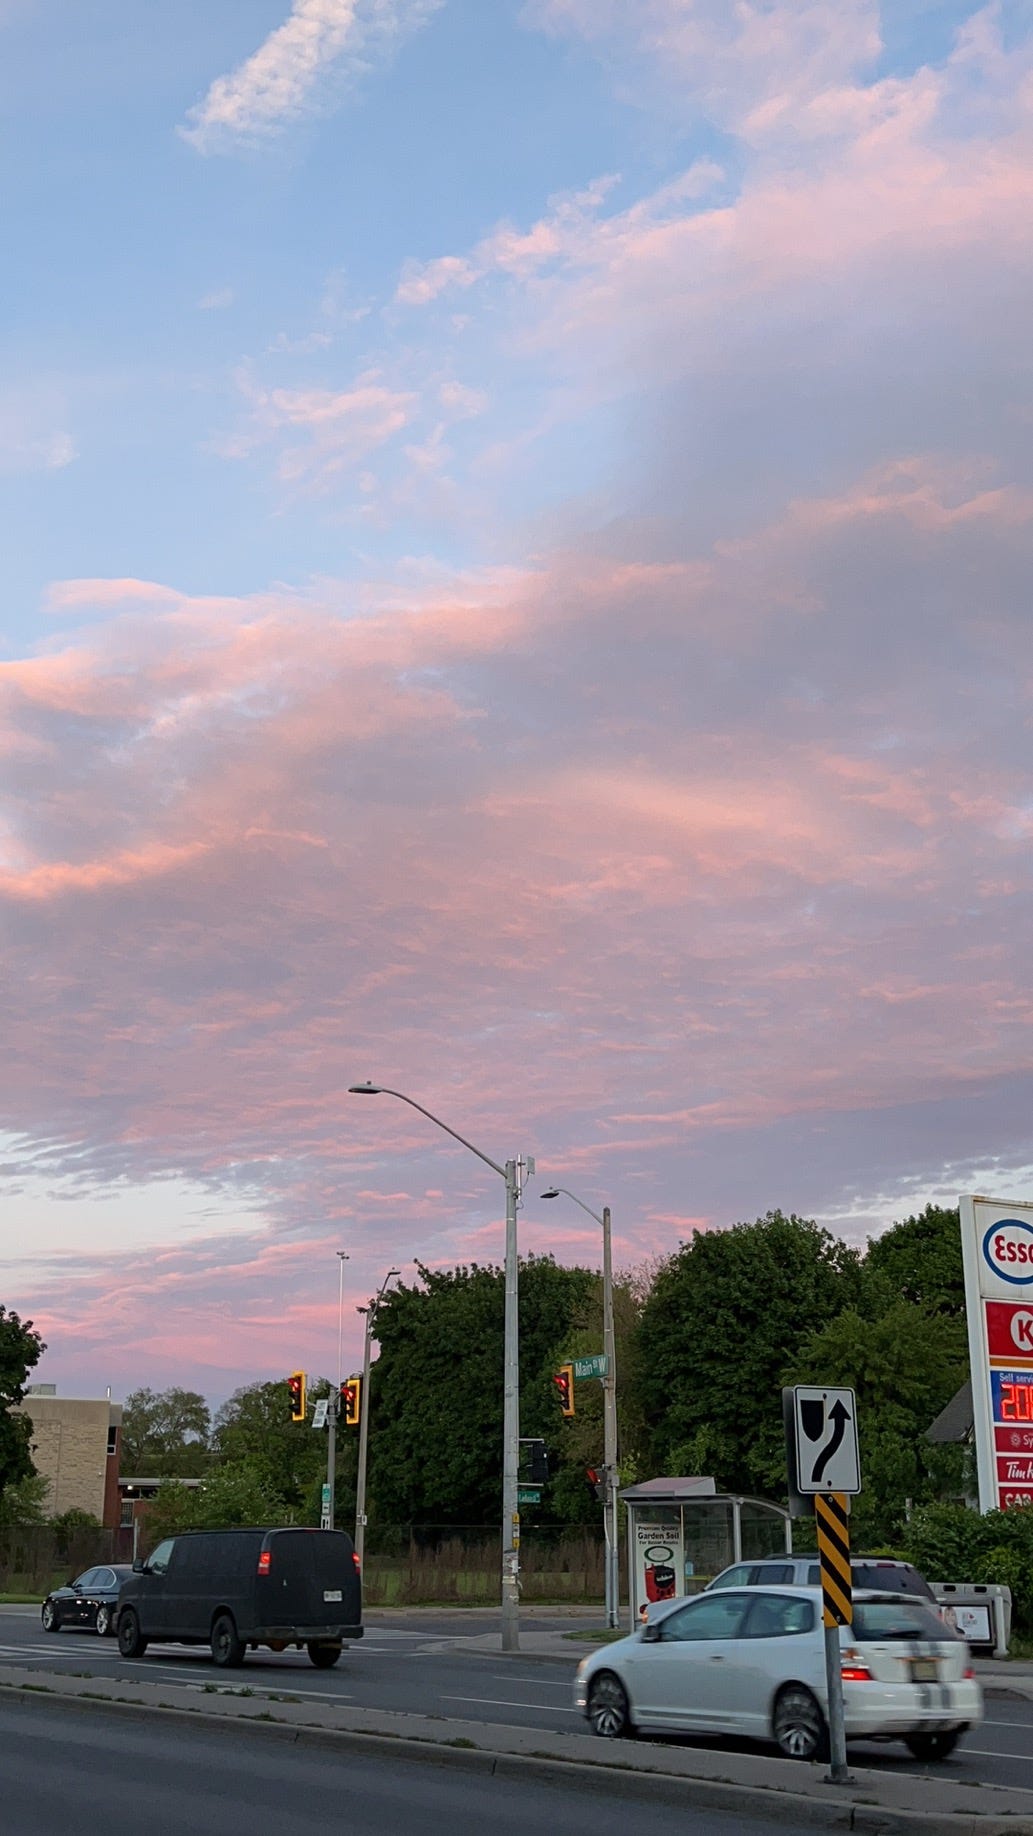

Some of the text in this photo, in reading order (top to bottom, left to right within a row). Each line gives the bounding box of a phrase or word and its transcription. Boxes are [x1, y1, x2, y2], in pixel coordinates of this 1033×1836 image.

[575, 1360, 593, 1378] Main
[598, 1357, 606, 1373] W
[1006, 1461, 1026, 1480] Tim
[638, 1532, 680, 1540] Garden Soil
